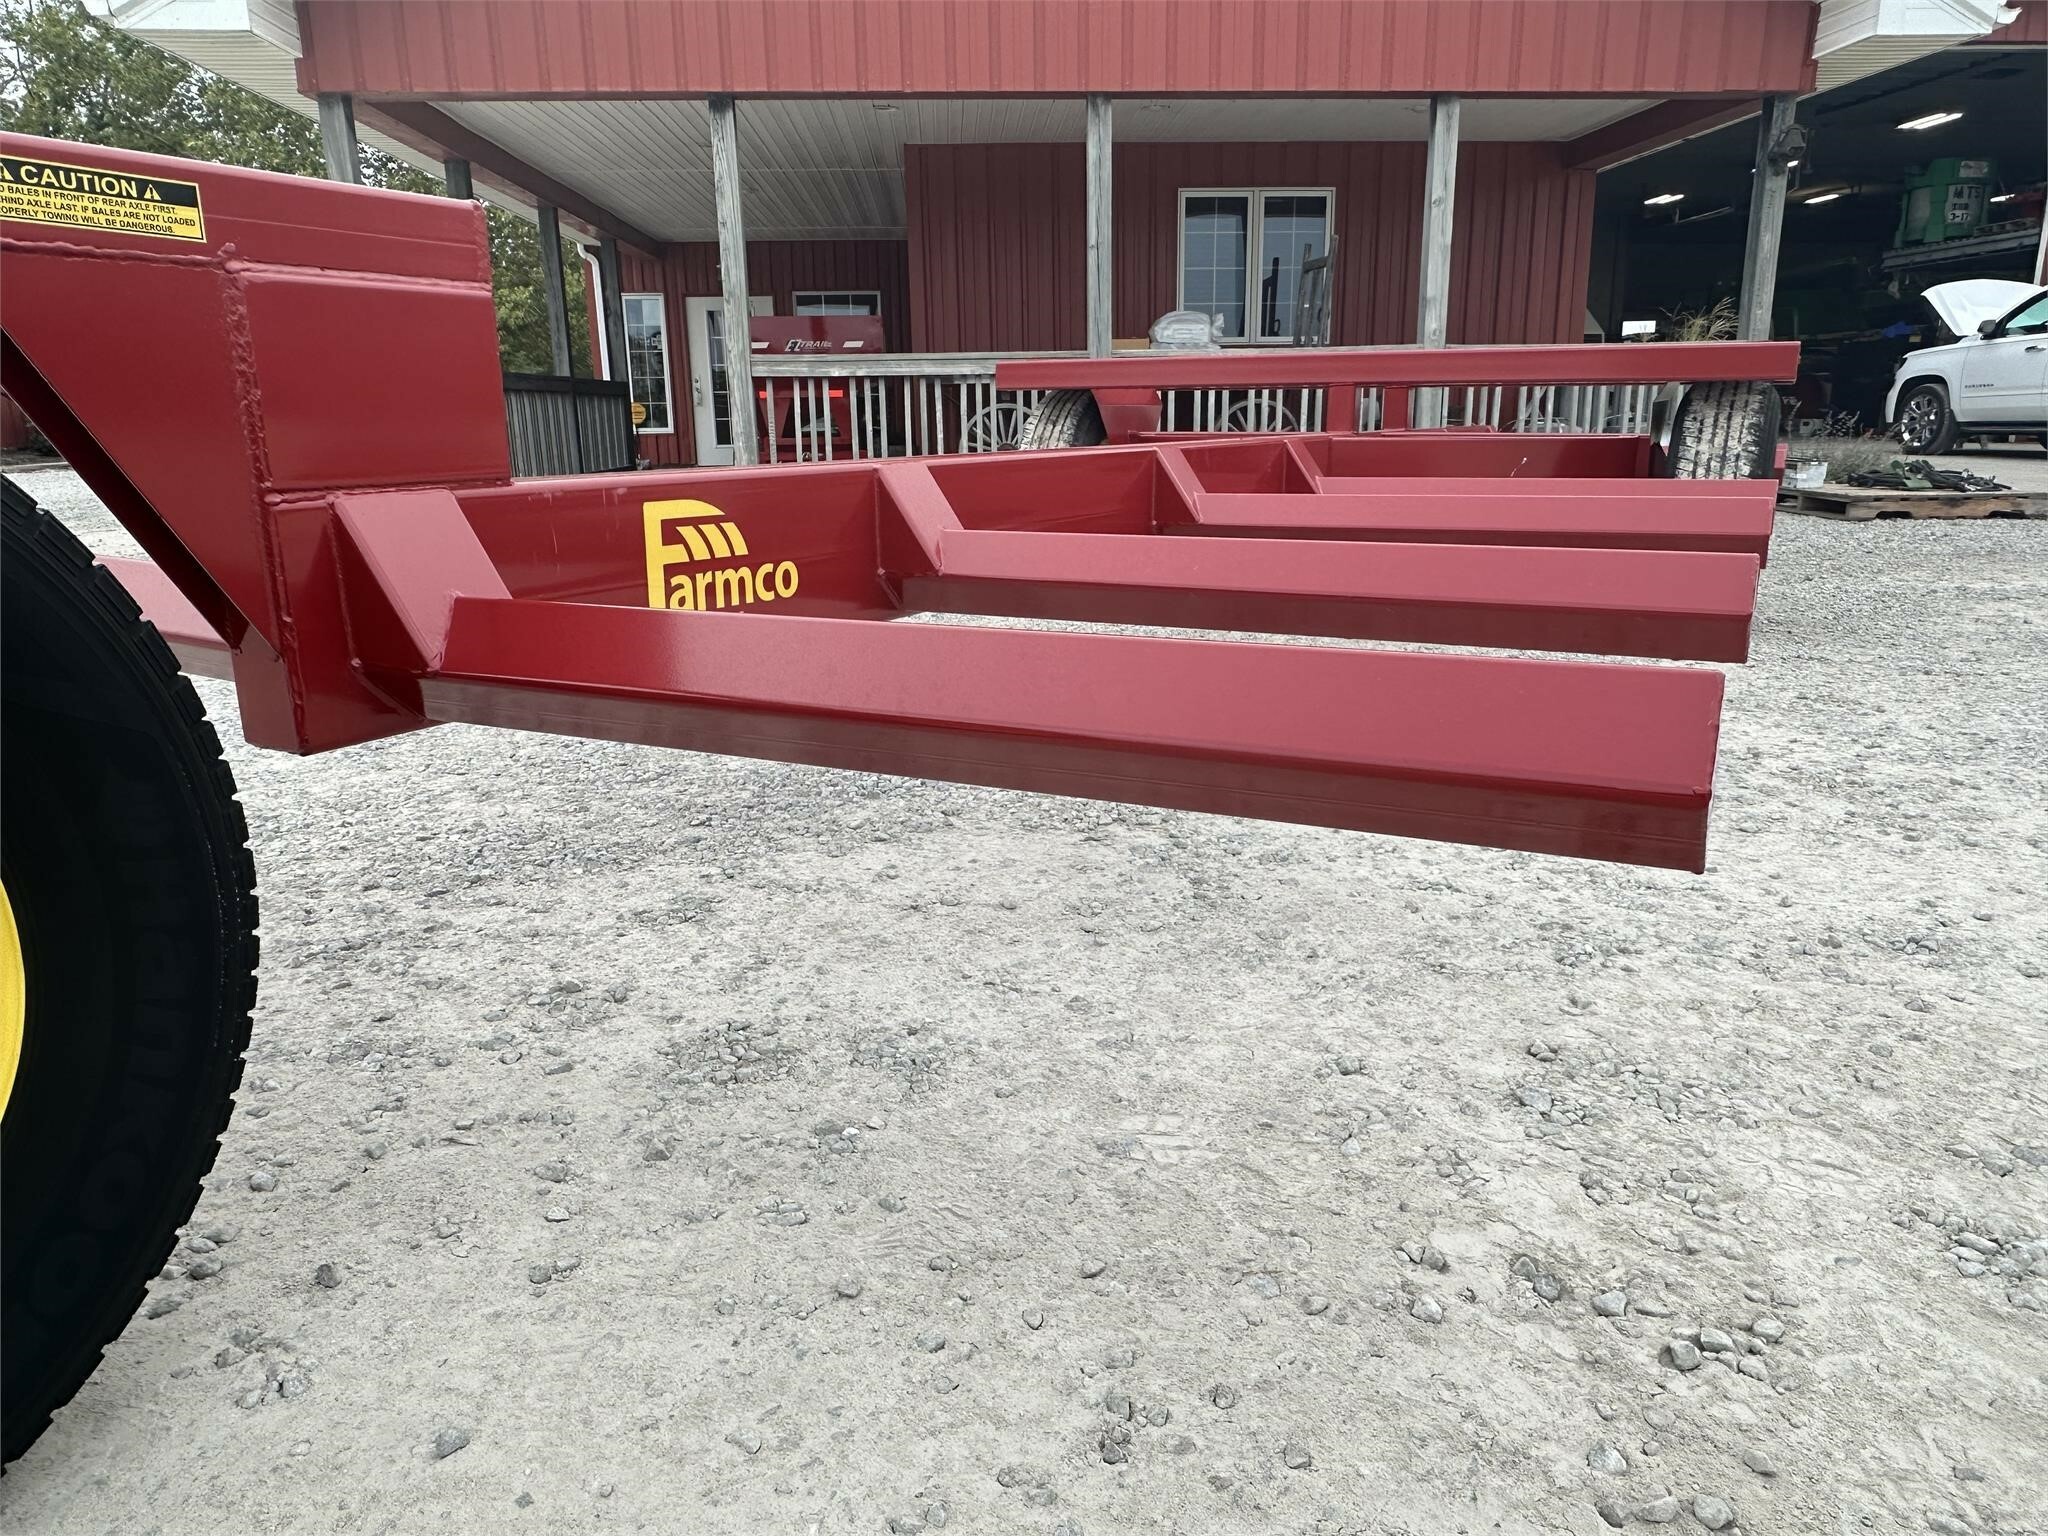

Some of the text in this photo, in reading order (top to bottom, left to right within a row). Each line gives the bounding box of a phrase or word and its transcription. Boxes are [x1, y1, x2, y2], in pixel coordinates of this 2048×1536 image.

[20, 165, 138, 198] CAUTION
[0, 195, 25, 207] HIND
[26, 198, 52, 209] AXLE
[53, 202, 80, 213] LAST.
[91, 207, 121, 218] BALES
[123, 210, 141, 219] ARE
[143, 213, 161, 222] NOT
[162, 216, 196, 227] LOADED
[7, 185, 40, 197] BALES
[41, 189, 52, 199] IN
[53, 191, 85, 202] FRONT
[87, 196, 100, 205] OF
[102, 198, 126, 209] REAR
[128, 201, 151, 212] AXLE
[0, 205, 176, 234] OPERLY TOWING WILL BE DANGEROUS.
[643, 499, 799, 611] Farmco
